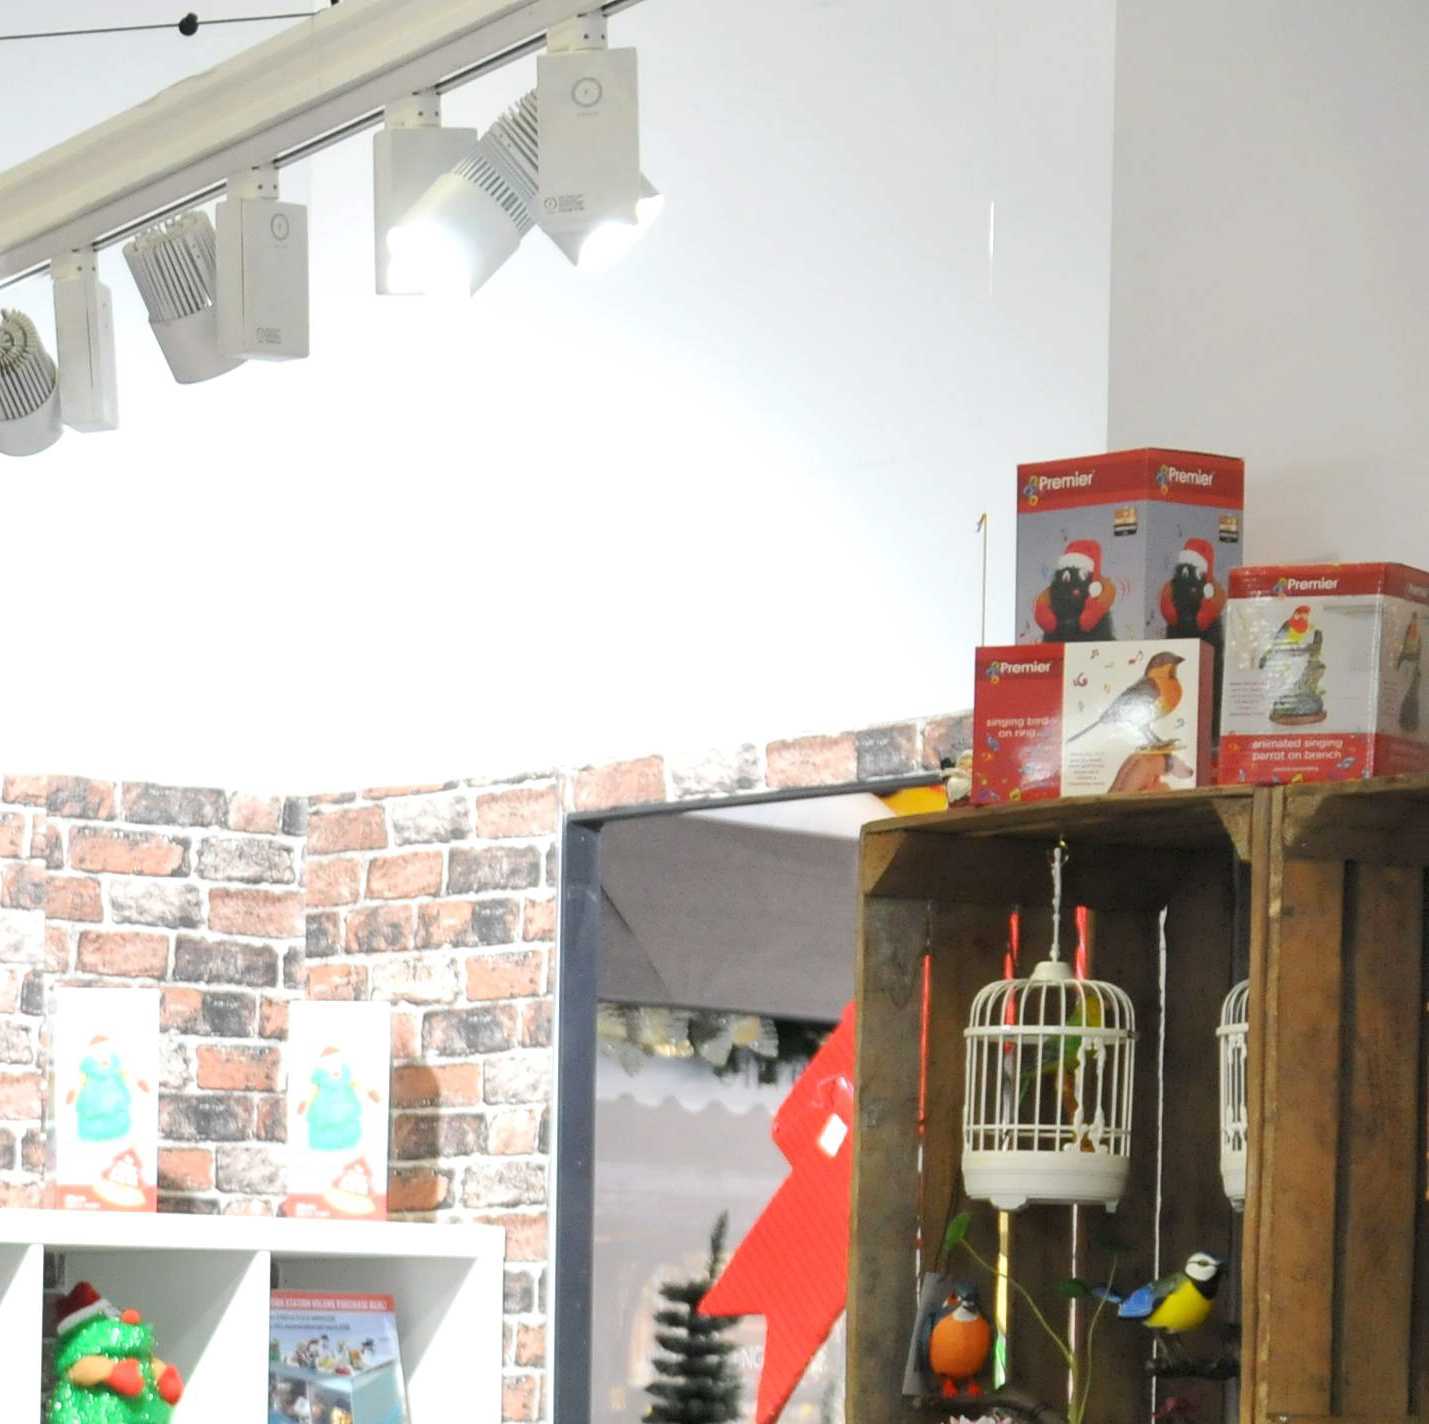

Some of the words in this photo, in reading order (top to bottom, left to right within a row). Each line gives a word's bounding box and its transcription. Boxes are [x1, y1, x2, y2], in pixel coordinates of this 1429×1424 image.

[1039, 471, 1094, 491] Premier
[1169, 467, 1213, 485] Premier
[1288, 578, 1339, 590] Premier
[1000, 661, 1051, 673] Premier
[986, 717, 1024, 728] singing
[1253, 739, 1301, 748] animated
[1304, 738, 1343, 749] singing
[1253, 751, 1285, 761] parrot
[1287, 751, 1302, 759] on
